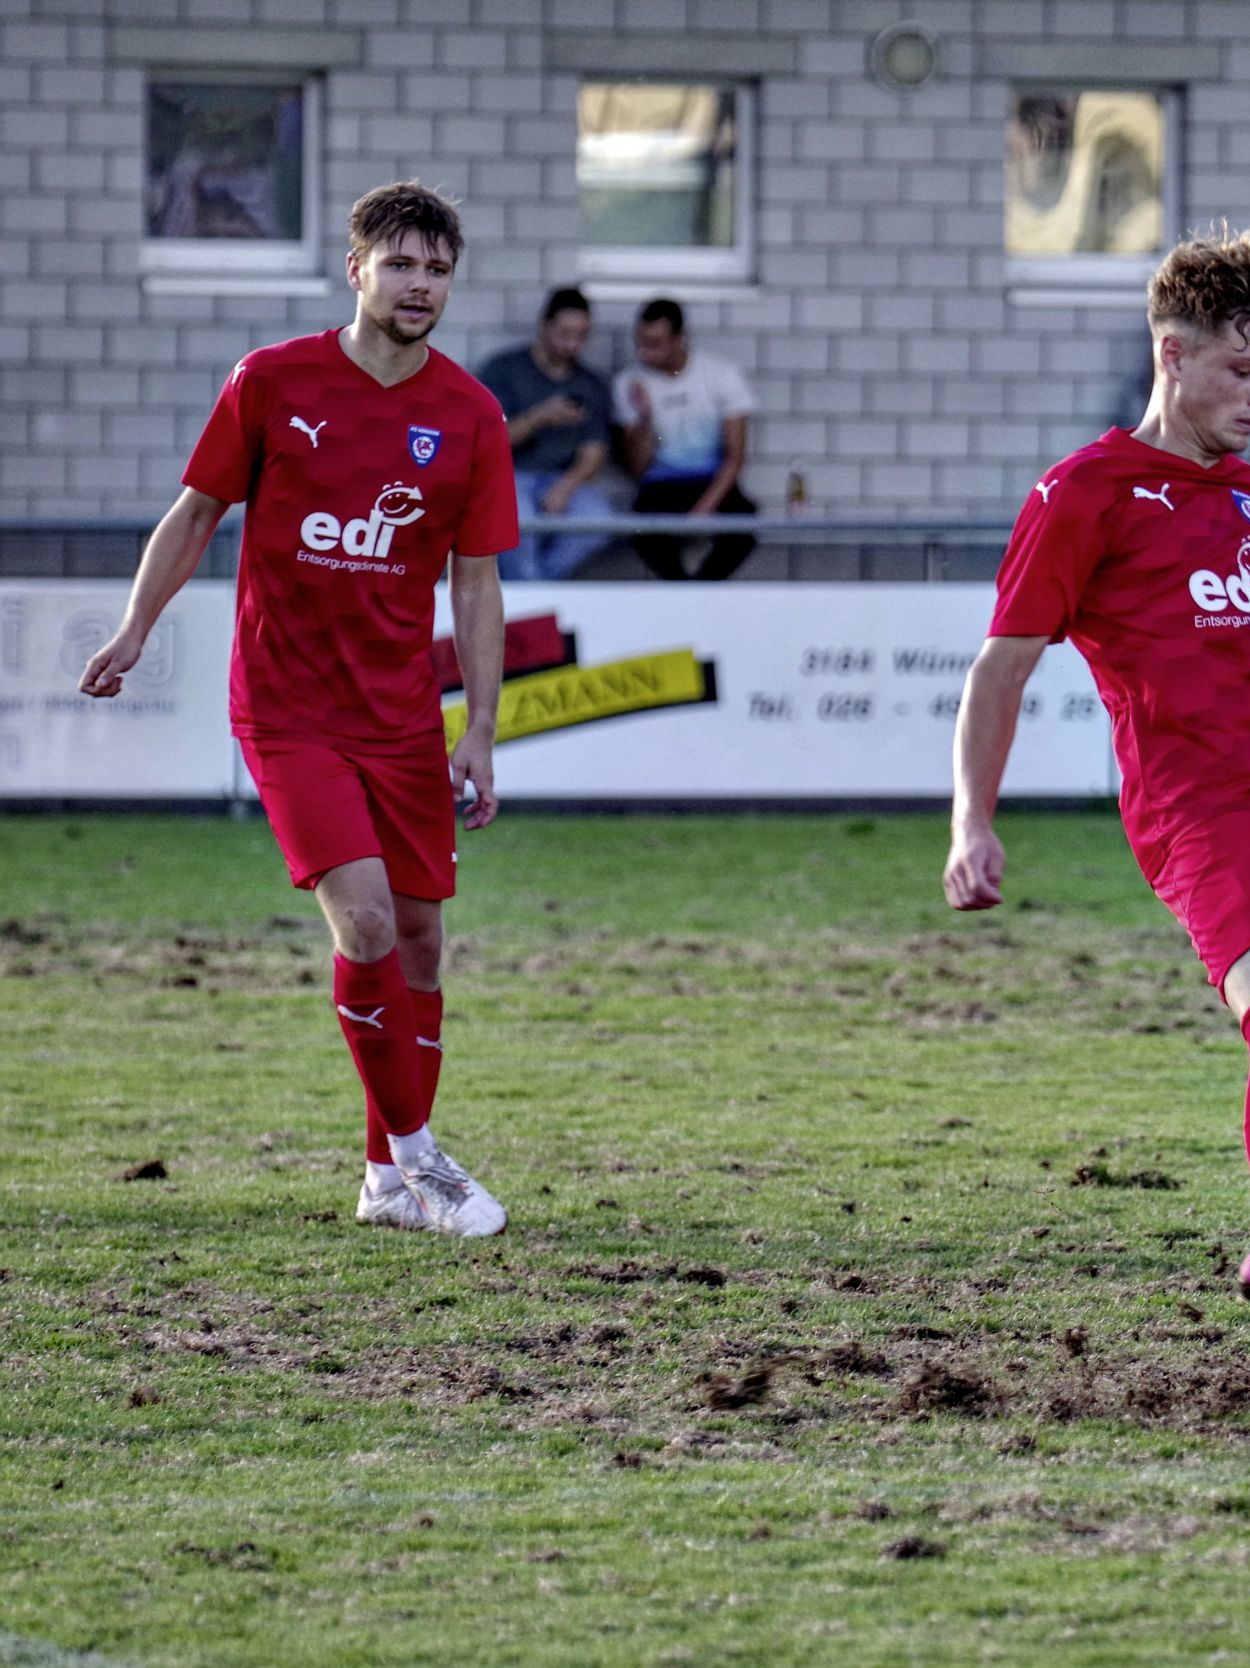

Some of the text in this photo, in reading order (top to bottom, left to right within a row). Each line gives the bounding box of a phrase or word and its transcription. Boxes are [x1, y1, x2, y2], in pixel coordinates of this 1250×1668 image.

[301, 499, 407, 558] edi
[390, 564, 406, 576] AG
[893, 647, 979, 676] Wünn
